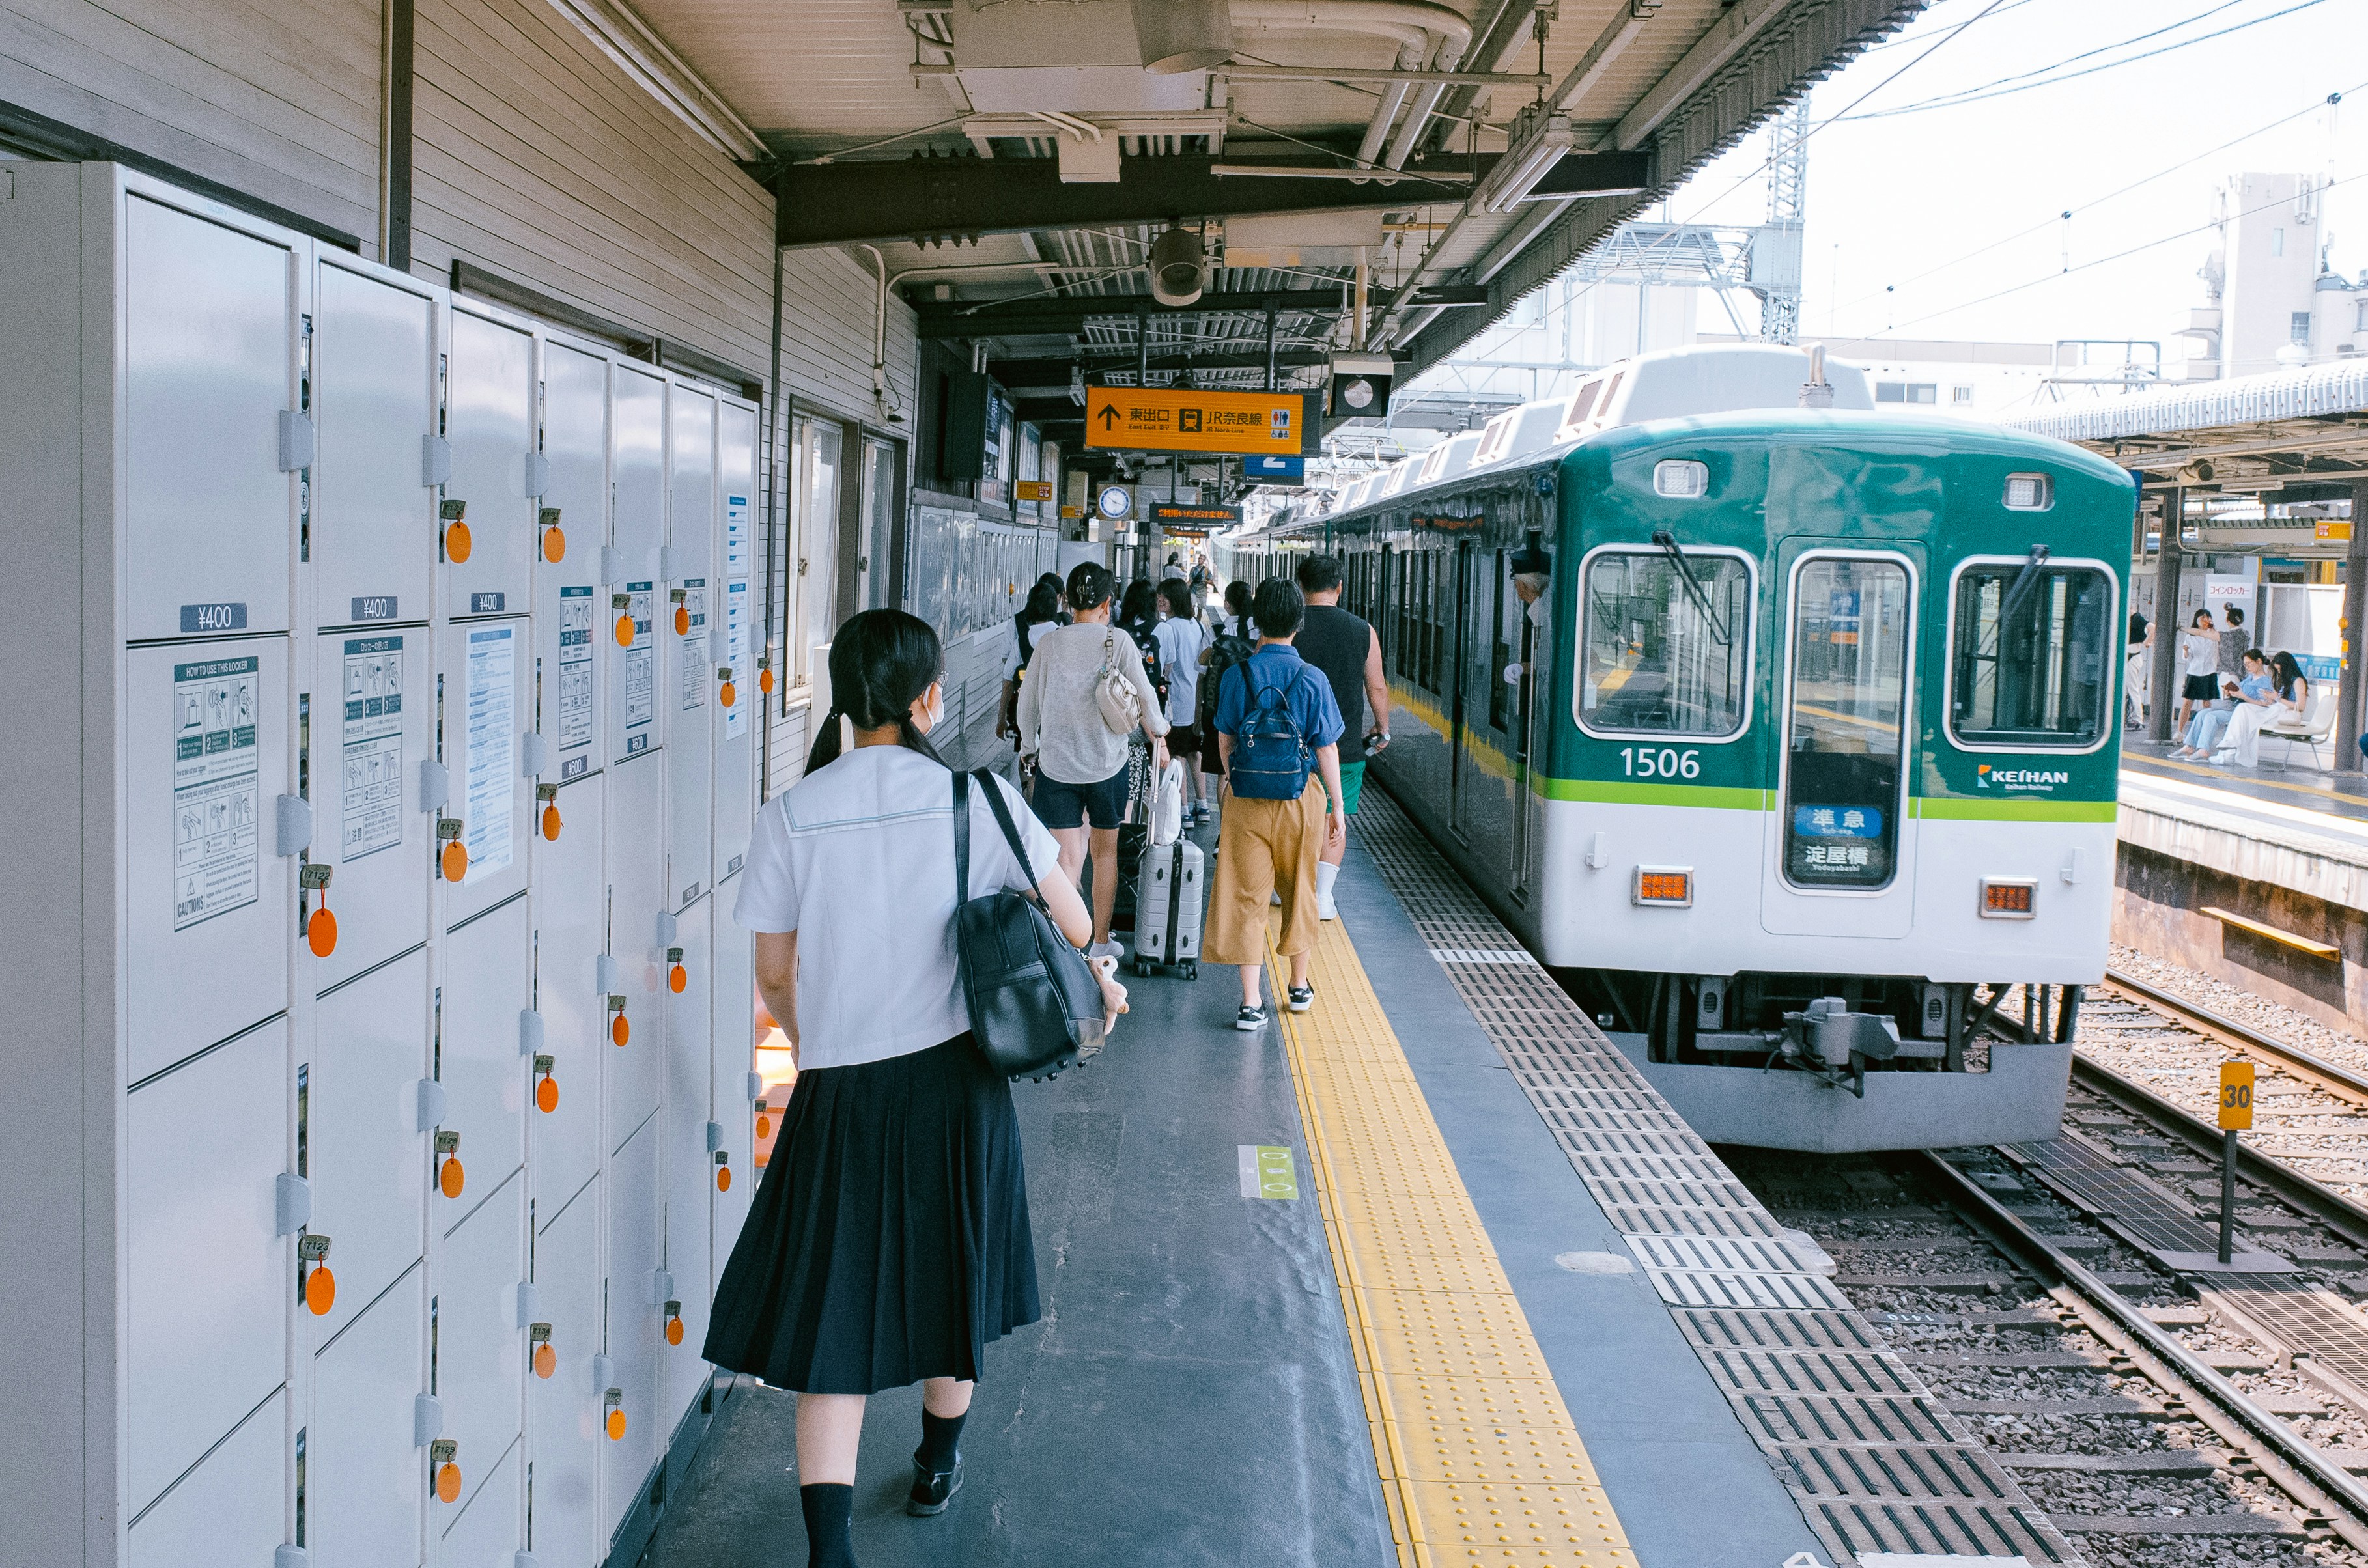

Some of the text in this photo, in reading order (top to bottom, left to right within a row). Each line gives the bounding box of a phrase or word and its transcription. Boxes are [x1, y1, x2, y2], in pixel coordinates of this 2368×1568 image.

[1130, 408, 1170, 422] 東出口
[1206, 411, 1262, 425] JR奈良線
[2210, 586, 2250, 595] コインロッカー
[363, 598, 388, 619] ¥400
[479, 594, 498, 611] ¥400
[198, 605, 233, 629] ¥400
[186, 660, 248, 677] HOW TO USE THIS LOCKER
[206, 737, 212, 751] 2
[233, 733, 238, 746] 3
[632, 735, 644, 751] ¥600
[178, 743, 182, 757] 1
[568, 759, 582, 776] ¥600
[1620, 748, 1700, 779] 1506
[1992, 769, 2068, 783] KEIHAN
[1812, 809, 1865, 828] 準急
[206, 841, 210, 853] 2
[233, 833, 236, 845] 3
[178, 850, 182, 862] 1
[1805, 845, 1868, 865] 淀屋橋
[178, 896, 204, 918] CAUTIONS
[2223, 1084, 2251, 1108] 30
